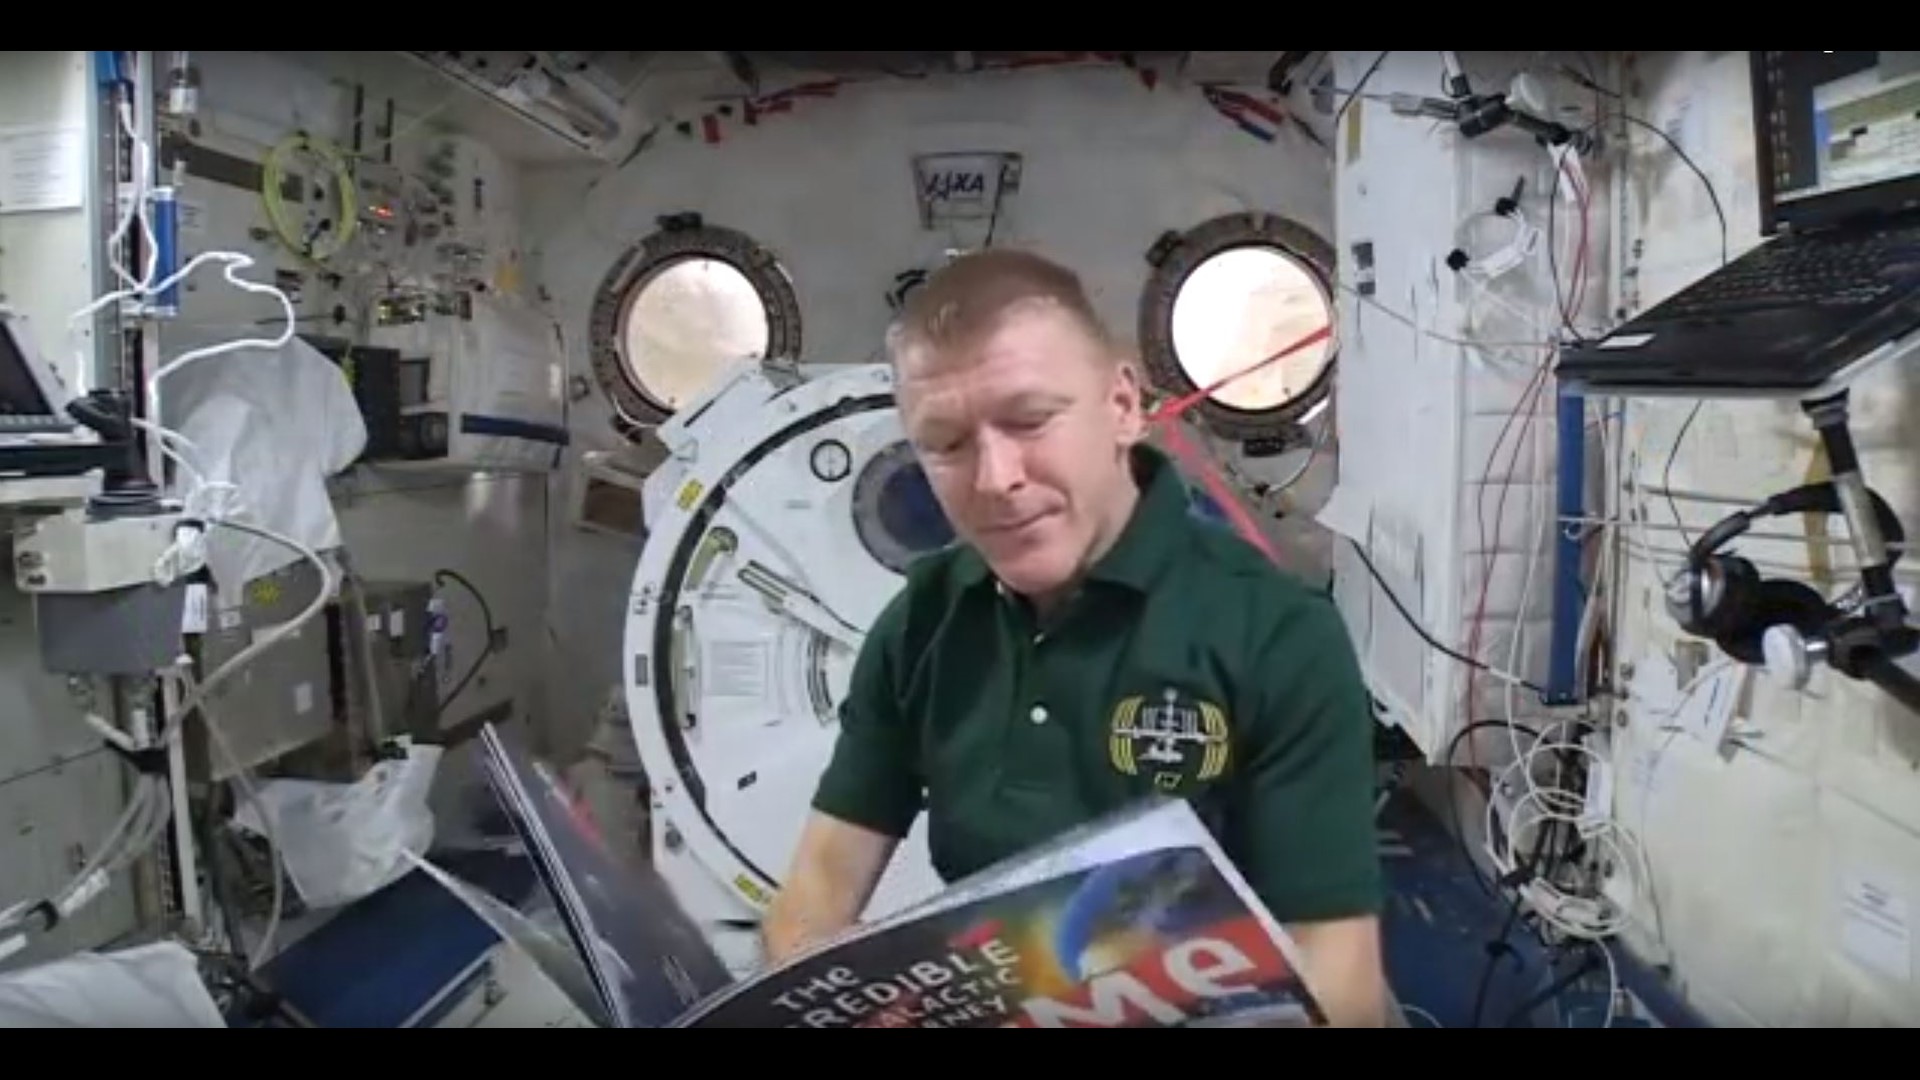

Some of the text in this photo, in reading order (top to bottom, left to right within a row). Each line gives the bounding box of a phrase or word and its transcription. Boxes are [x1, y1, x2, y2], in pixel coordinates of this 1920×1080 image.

[784, 939, 1019, 1028] REDIBLE
[856, 967, 1021, 1028] ALACTIC
[1003, 938, 1258, 1028] Me
